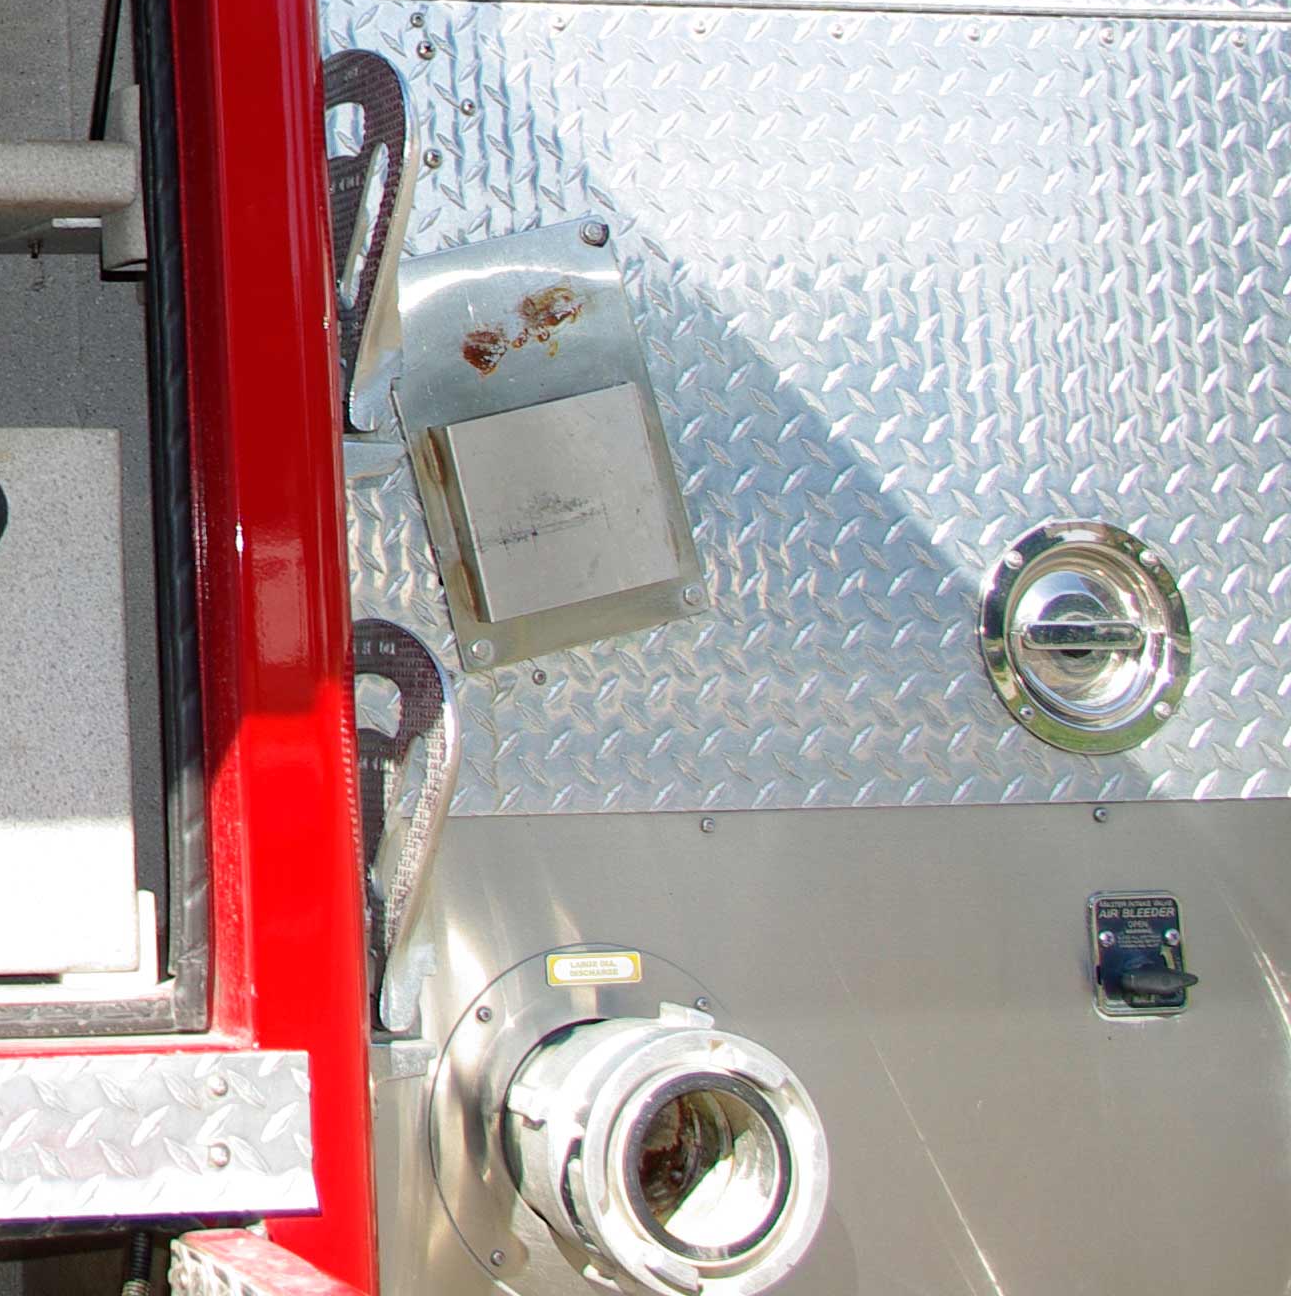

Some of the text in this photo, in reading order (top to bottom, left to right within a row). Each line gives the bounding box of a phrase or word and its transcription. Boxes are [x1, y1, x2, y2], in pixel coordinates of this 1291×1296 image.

[1098, 907, 1175, 919] AIR BLEEDER
[1127, 920, 1149, 928] OPEN
